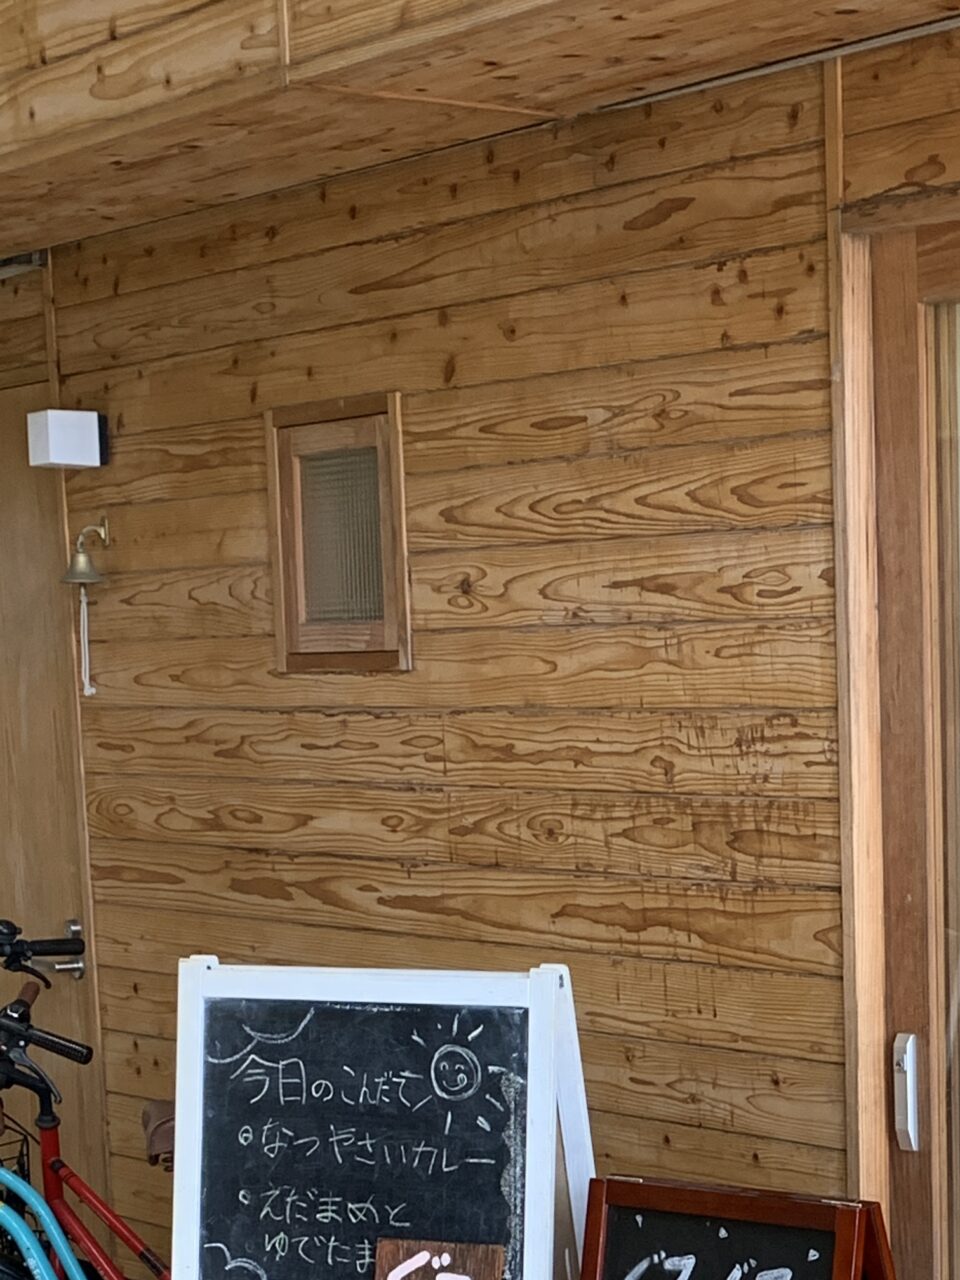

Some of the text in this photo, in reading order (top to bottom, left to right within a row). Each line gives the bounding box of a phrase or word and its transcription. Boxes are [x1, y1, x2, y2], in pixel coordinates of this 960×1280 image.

[230, 1054, 424, 1111] 今日のこんだて
